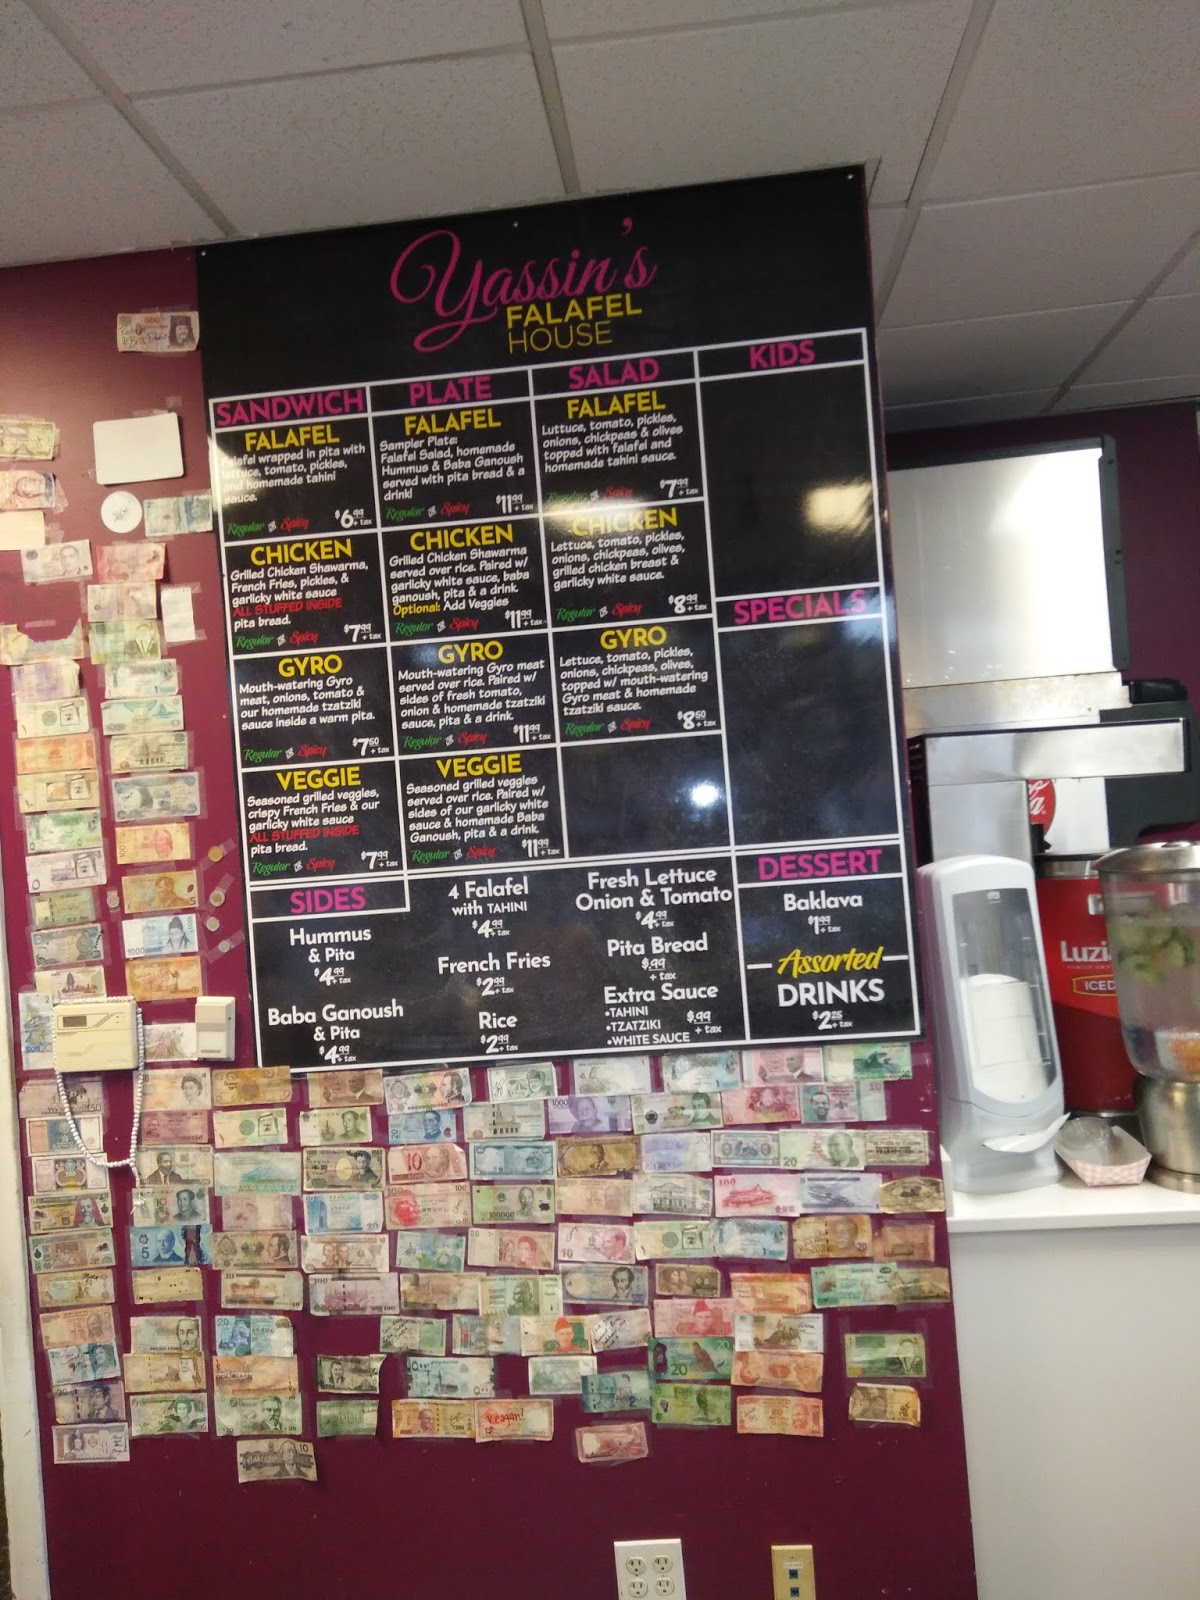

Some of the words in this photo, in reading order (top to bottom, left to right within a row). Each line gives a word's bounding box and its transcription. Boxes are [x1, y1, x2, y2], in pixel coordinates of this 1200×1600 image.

[390, 216, 657, 352] Yassin's
[506, 293, 642, 328] FALAFEL
[508, 321, 613, 354] HOUSE
[750, 340, 816, 370] KIDS
[568, 358, 660, 390] SALAD
[409, 375, 492, 406] PLATE
[217, 389, 364, 426] SANDWICH
[567, 390, 666, 419] FALAFEL
[405, 408, 501, 435] FALAFEL
[590, 419, 634, 431] tomato,
[637, 413, 676, 429] pickles,
[245, 424, 340, 451] FALAFEL
[380, 438, 425, 452] Sampler
[428, 436, 458, 448] Plate:
[543, 437, 581, 448] onions,
[584, 431, 637, 446] chickpeas
[640, 427, 648, 437] &
[653, 425, 683, 436] olives
[258, 449, 303, 465] wrapped
[307, 448, 315, 459] in
[319, 448, 340, 461] pita
[343, 444, 366, 455] with
[264, 464, 307, 476] tomato,
[310, 459, 347, 474] pickles,
[382, 463, 428, 476] Hummus
[432, 461, 440, 471] &
[443, 458, 471, 470] Baba
[474, 455, 523, 468] Ganoush
[571, 507, 678, 536] CHICKEN
[410, 524, 514, 551] CHICKEN
[251, 538, 352, 566] CHICKEN
[389, 555, 423, 567] Grilled
[427, 551, 466, 563] Chicken
[470, 546, 527, 560] Shawarma
[230, 569, 264, 581] Grilled
[267, 566, 306, 577] Chicken
[309, 560, 368, 573] Shawarma,
[553, 564, 585, 579] grilled
[588, 559, 627, 573] chicken
[630, 556, 667, 569] breast
[670, 555, 679, 565] &
[231, 580, 266, 593] French
[269, 577, 297, 589] Fries,
[300, 575, 338, 589] pickles,
[341, 573, 349, 583] &
[233, 606, 252, 617] ALL
[255, 601, 303, 614] STUFFED
[306, 598, 342, 610] INSIDE
[393, 602, 440, 618] Optional:
[443, 600, 465, 611] Add
[469, 597, 509, 611] Veggies
[734, 590, 866, 625] SPECIALS
[600, 625, 667, 649] GYRO
[438, 640, 503, 664] GYRO
[278, 654, 343, 677] GYRO
[240, 678, 322, 694] Mouth-watering
[326, 676, 353, 689] Gyro
[561, 679, 600, 693] topped
[603, 676, 617, 687] w/
[621, 671, 708, 686] mouth-watering
[240, 695, 270, 706] meat,
[272, 692, 310, 704] onions,
[313, 688, 353, 700] tomato
[357, 686, 365, 696] &
[400, 694, 428, 705] sides
[432, 692, 443, 702] of
[447, 689, 475, 701] fresh
[479, 687, 522, 698] tomato,
[562, 693, 589, 706] Gyro
[593, 689, 621, 701] meat
[624, 687, 633, 698] &
[636, 684, 696, 697] homemade
[400, 706, 429, 718] onion
[432, 704, 441, 714] &
[444, 699, 502, 713] homemade
[505, 695, 545, 708] tzatziki
[563, 703, 603, 716] tzatziki
[607, 701, 642, 712] sauce.
[436, 753, 521, 779] VEGGIE
[276, 766, 361, 791] VEGGIE
[247, 794, 299, 807] Seasoned
[303, 791, 334, 805] grilled
[337, 788, 379, 802] veggies,
[407, 795, 442, 807] served
[445, 793, 469, 803] over
[472, 790, 493, 801] rice.
[496, 787, 529, 799] Paired
[532, 786, 545, 796] w/
[248, 808, 280, 820] crispy
[283, 804, 318, 816] French
[321, 801, 347, 814] Fries
[350, 800, 358, 811] &
[361, 800, 380, 810] our
[408, 807, 437, 819] sides
[440, 805, 452, 816] of
[455, 805, 473, 815] our
[476, 802, 517, 816] garlicky
[519, 799, 548, 810] white
[252, 861, 290, 876] Regular
[306, 857, 336, 872] Spicy
[758, 850, 882, 880] DESSERT
[448, 884, 459, 899] 4
[465, 876, 529, 898] Falafel
[588, 868, 639, 889] Fresh
[645, 868, 717, 886] Lettuce
[290, 886, 366, 914] SIDES
[452, 900, 483, 916] with
[487, 901, 527, 913] TAHINI
[576, 893, 633, 911] Onion
[640, 889, 655, 907] &
[660, 887, 732, 905] Tomato
[784, 890, 863, 911] Baklava
[290, 928, 372, 946] Hummus
[607, 939, 645, 957] Pita
[651, 932, 708, 954] Bread
[308, 948, 320, 962] &
[325, 948, 355, 962] Pita
[1060, 940, 1112, 962] Luzi
[438, 952, 500, 974] French
[506, 952, 551, 970] Fries
[777, 946, 884, 978] Assorted
[660, 972, 676, 980] tax
[1085, 979, 1116, 991] ICED
[604, 986, 655, 1004] Extra
[661, 983, 719, 1000] Sauce
[778, 979, 885, 1007] DRINKS
[268, 1006, 317, 1025] Baba
[322, 998, 404, 1022] Ganoush
[479, 1012, 518, 1029] Rice
[313, 1027, 326, 1041] &
[331, 1026, 360, 1040] Pita
[652, 1032, 690, 1044] SAUCE
[705, 1025, 721, 1033] tax
[405, 1152, 422, 1171] 10
[783, 1157, 797, 1167] 20
[141, 1246, 149, 1259] 5
[717, 1341, 730, 1350] 20
[671, 1364, 688, 1375] 20
[298, 1444, 308, 1452] 10
